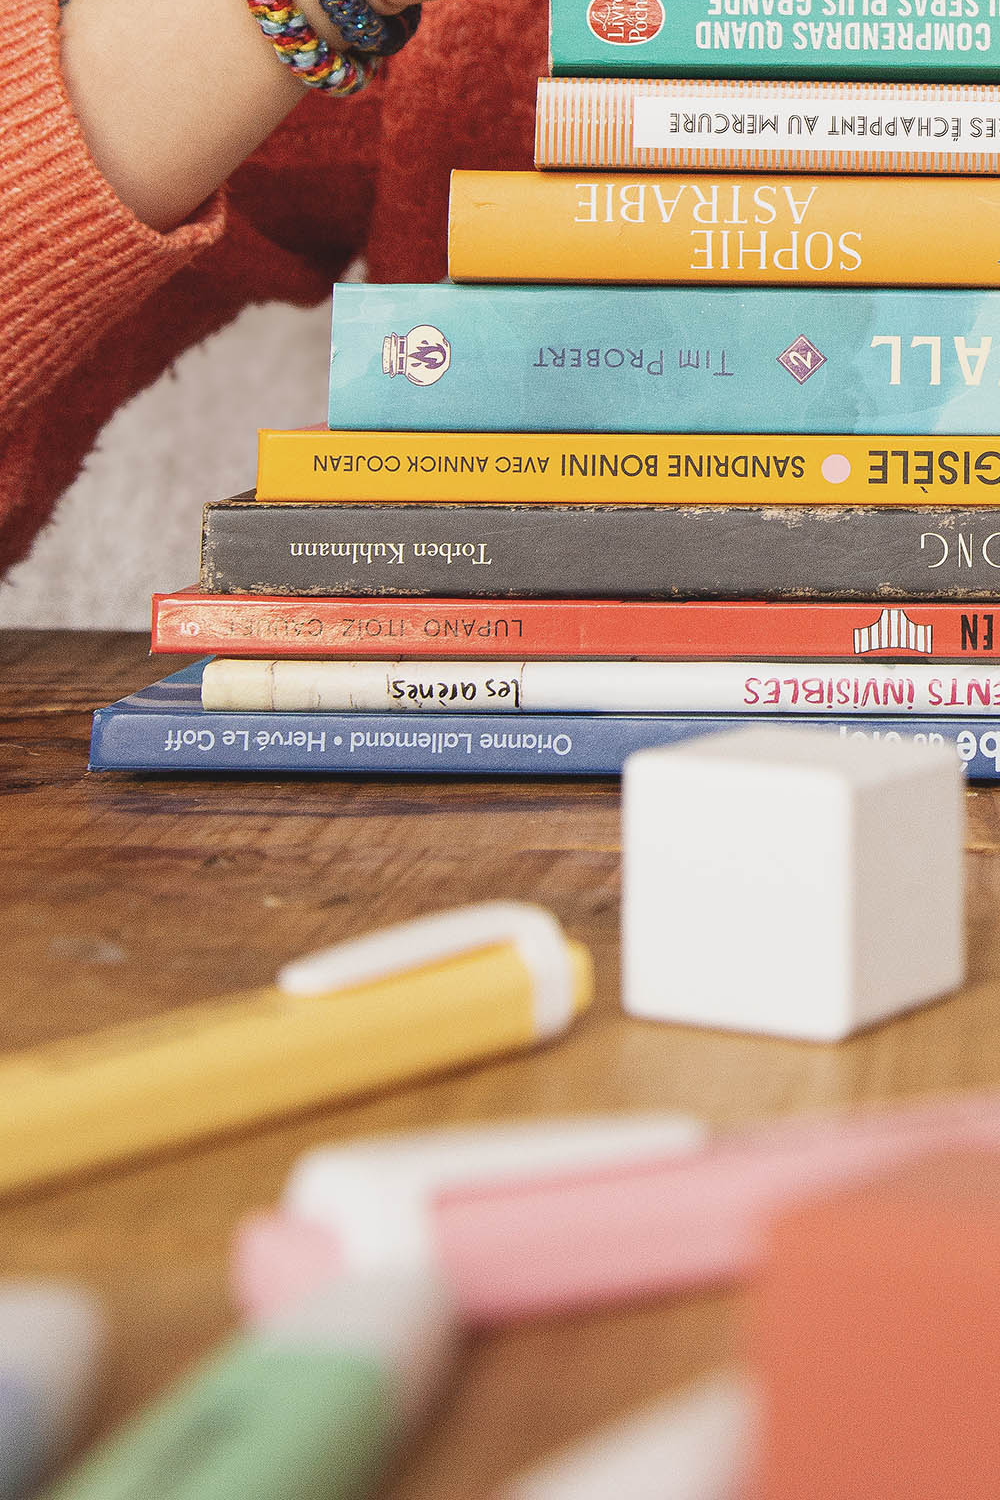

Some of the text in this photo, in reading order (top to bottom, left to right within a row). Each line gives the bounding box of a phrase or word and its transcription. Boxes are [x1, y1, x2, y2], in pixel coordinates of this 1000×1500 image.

[592, 4, 609, 31] Le
[695, 21, 783, 50] QUAND
[793, 22, 991, 50] COMPRENDRAS
[670, 114, 779, 135] MERCURE
[788, 116, 819, 136] AU
[574, 184, 818, 224] ASTRABIE
[689, 230, 862, 270] SOPHIE
[313, 454, 805, 478] SANDRINE BONINI AVEC ANNICK COJEAN
[290, 542, 492, 564] Torben Kuhlmann
[423, 618, 523, 636] LUPANO
[960, 614, 993, 650] EN
[486, 679, 520, 707] les
[164, 729, 573, 754] Orianne Lallemand Hervé Le Goff
